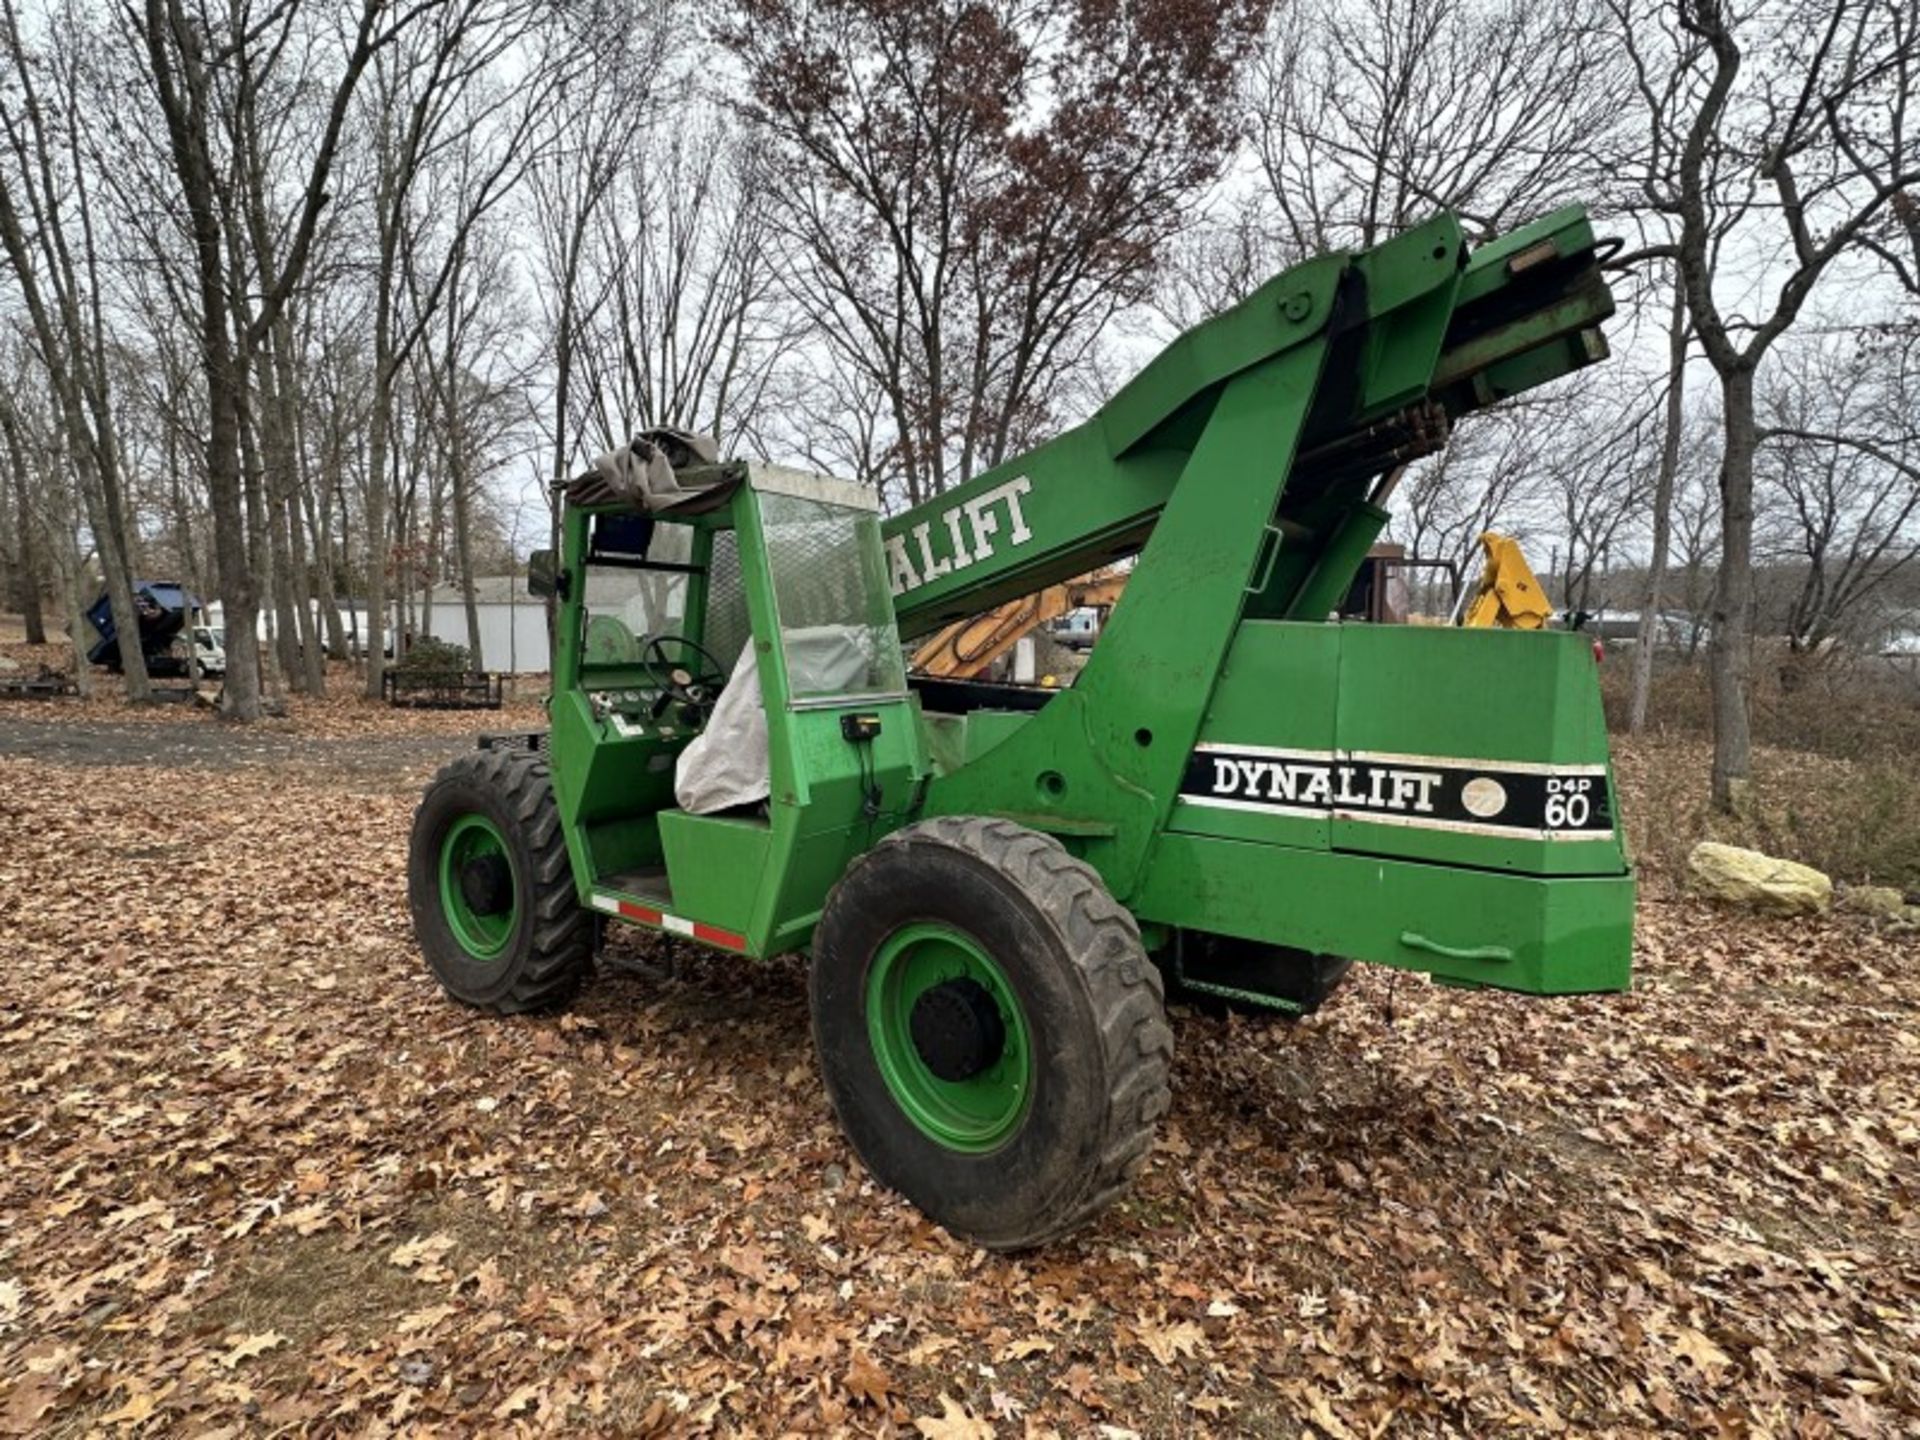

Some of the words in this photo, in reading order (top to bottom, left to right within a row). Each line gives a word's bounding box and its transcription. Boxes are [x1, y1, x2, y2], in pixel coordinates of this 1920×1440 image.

[1212, 758, 1443, 812] DYNALIFT
[1547, 778, 1591, 793] D4P
[1545, 793, 1589, 826] 60
